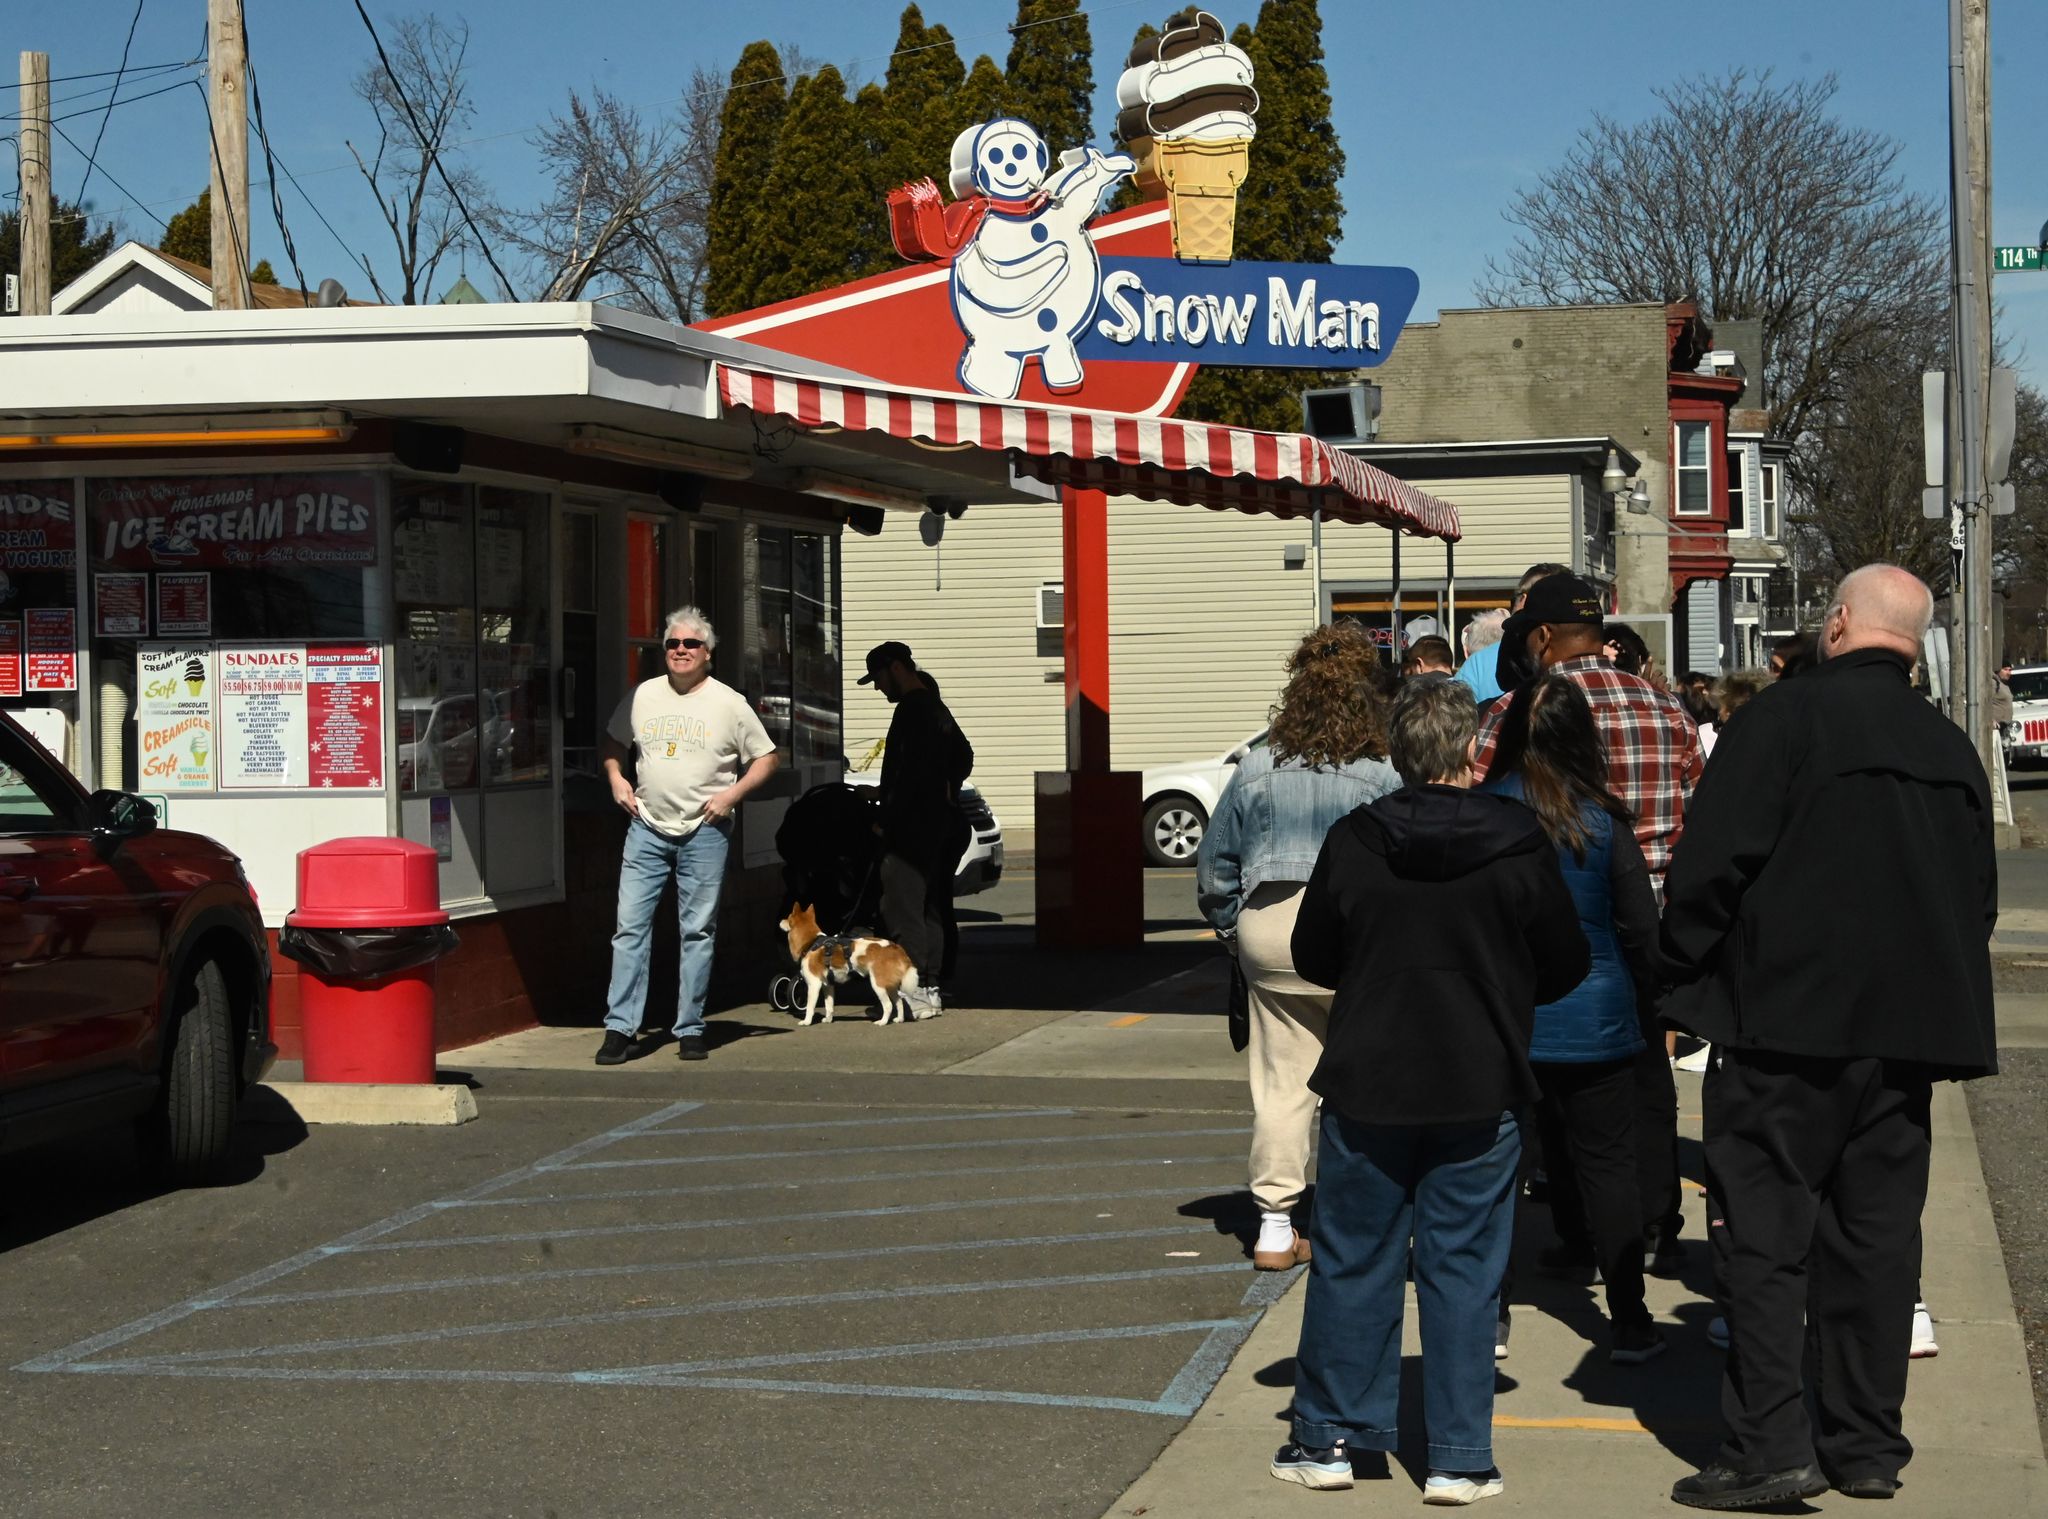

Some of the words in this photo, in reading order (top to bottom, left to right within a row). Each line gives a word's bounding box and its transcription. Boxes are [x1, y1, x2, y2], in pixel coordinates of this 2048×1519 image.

[2000, 248, 2025, 267] 114
[2026, 247, 2038, 259] Th
[1097, 270, 1257, 345] Snow
[1267, 276, 1380, 350] Man
[170, 487, 254, 513] HOMEMADE
[103, 516, 166, 561] ICE
[179, 497, 284, 541] CREAM
[295, 492, 369, 535] PIES
[257, 546, 293, 561] All
[141, 653, 162, 662] SOFT
[164, 646, 177, 658] ICE
[144, 660, 174, 672] CREAM
[175, 649, 210, 665] FLAVORS
[225, 652, 300, 666] SUNDAES
[342, 654, 372, 662] SUNDAES
[144, 678, 177, 699] Soft
[223, 681, 241, 692] $5.50
[243, 681, 262, 692] $6.75
[263, 681, 282, 692] $9.00
[283, 681, 302, 692] $10.00
[143, 716, 212, 753] CREAMSICLE
[641, 714, 706, 750] SIENA
[666, 742, 677, 757] S
[143, 753, 178, 779] Soft
